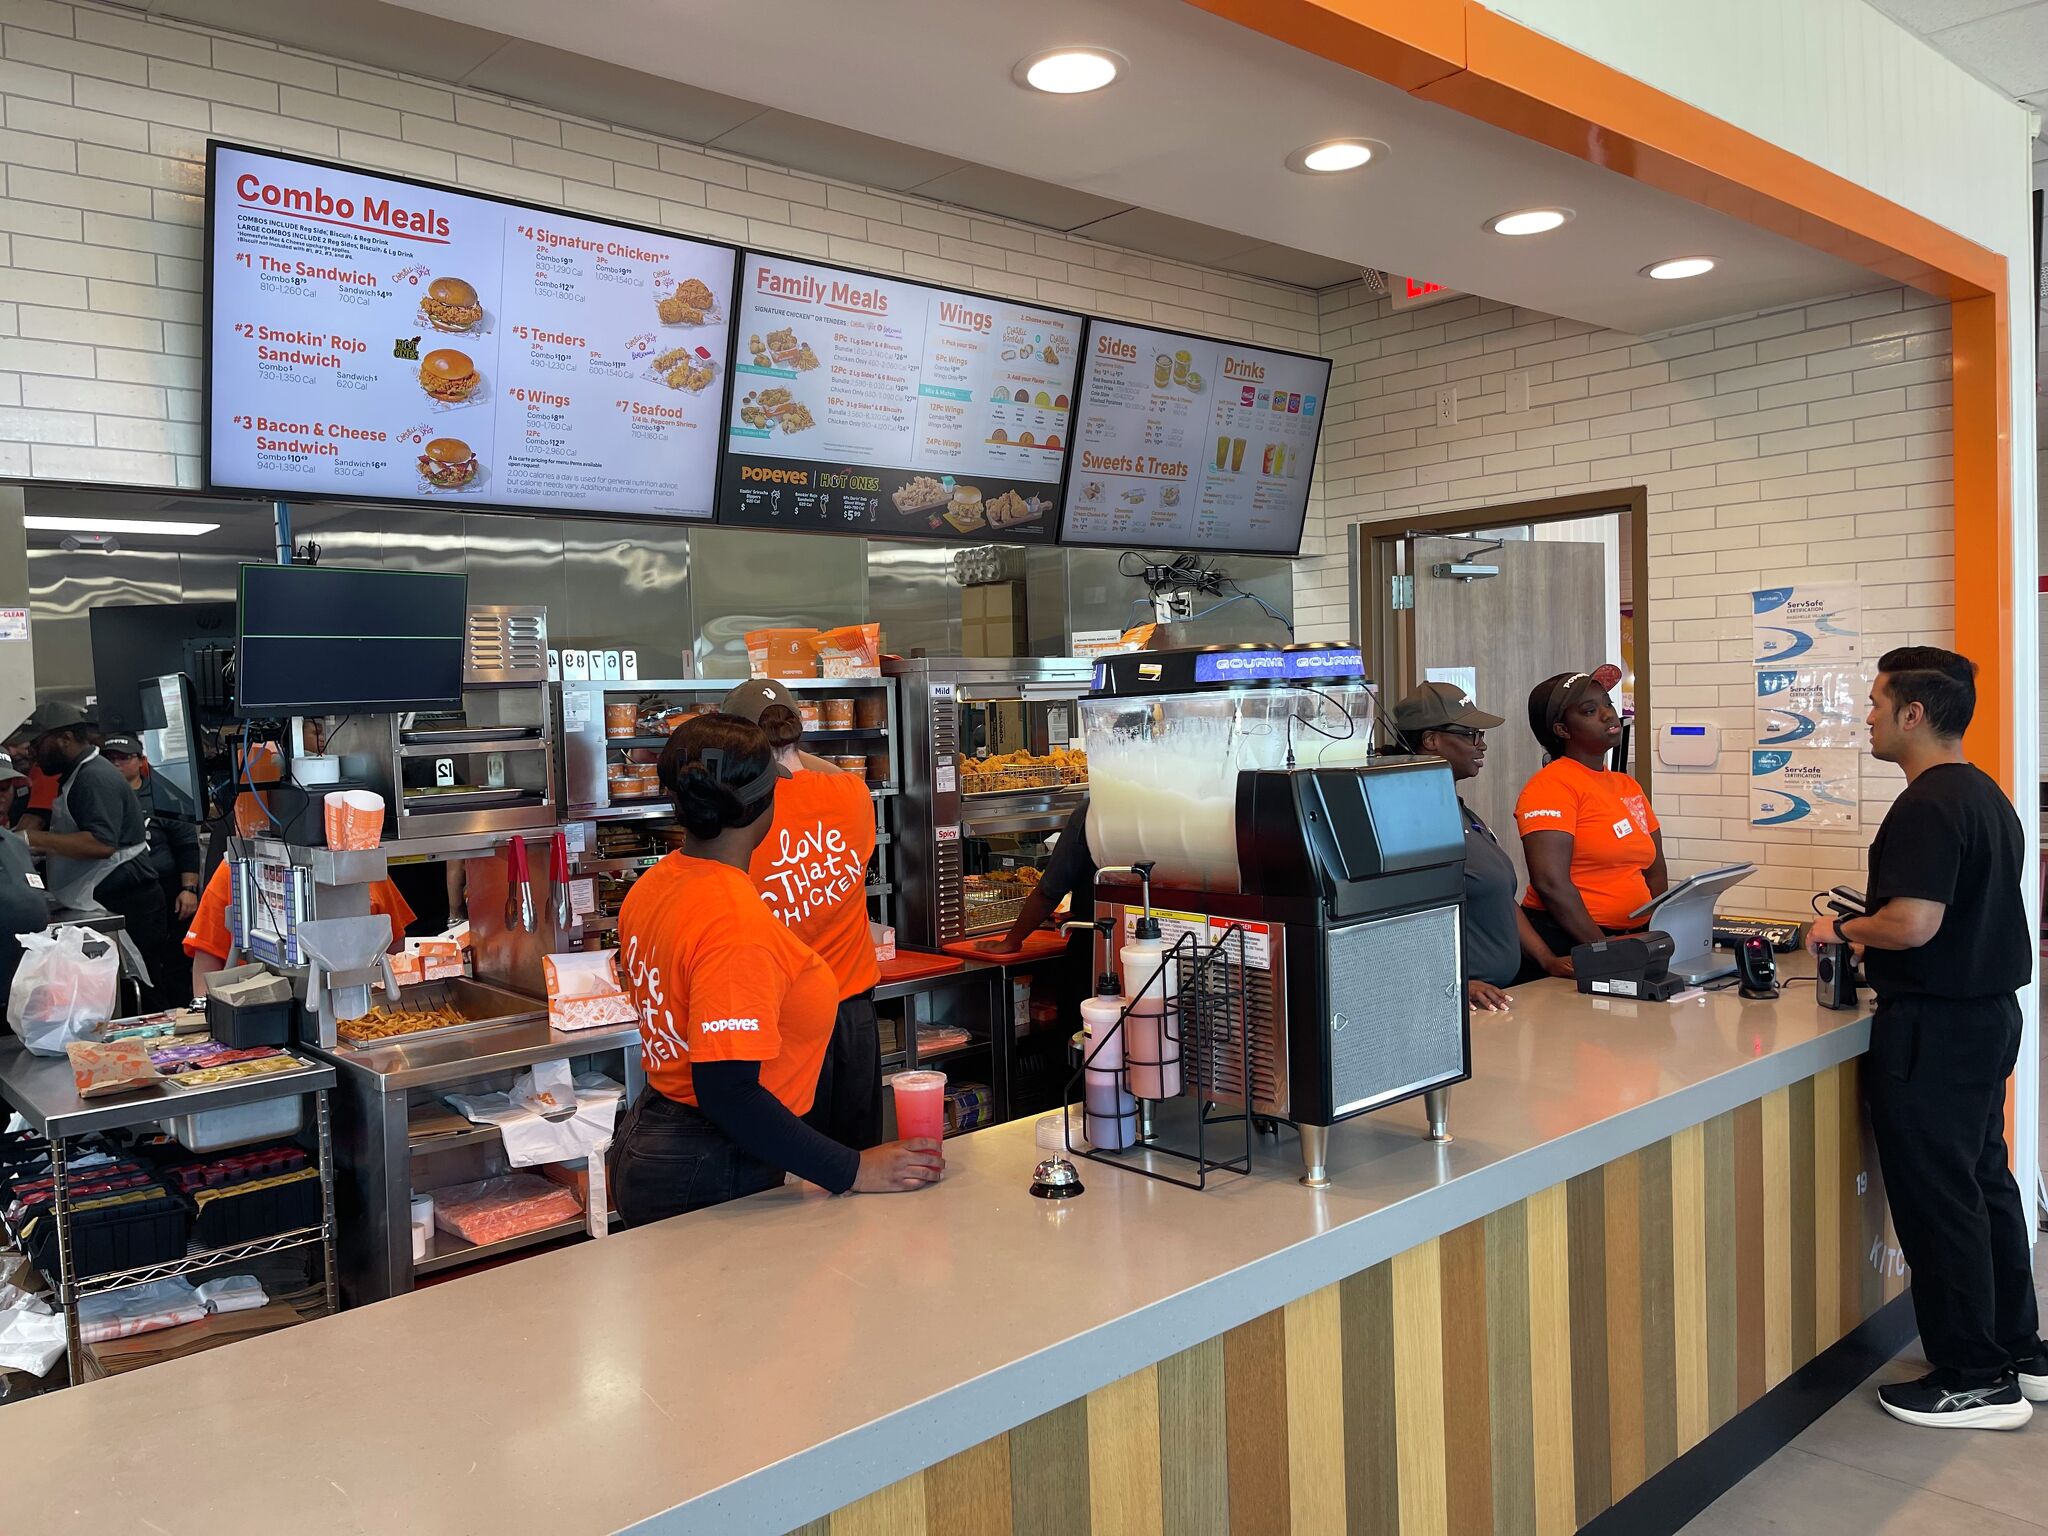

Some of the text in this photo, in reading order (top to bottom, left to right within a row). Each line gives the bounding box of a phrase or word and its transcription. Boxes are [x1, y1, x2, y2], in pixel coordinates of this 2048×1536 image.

[236, 173, 451, 237] Combo Meals
[237, 214, 389, 246] COMBOS INCLUDE Reg Reg Drink
[237, 222, 414, 259] LARGE COMBOS INCLUDE Reg Drink
[517, 225, 604, 253] #4 Signature
[536, 245, 549, 254] 2Pc
[535, 253, 560, 264] Combo
[596, 256, 609, 264] 3Pc
[235, 253, 377, 287] #1 The Sandwich
[571, 267, 584, 277] Cal
[595, 264, 619, 274] Combo
[260, 272, 290, 284] Combo
[534, 279, 559, 289] Combo
[756, 267, 888, 311] Family Meals
[302, 288, 317, 298] Cal
[338, 284, 376, 297] Sandwich
[339, 293, 370, 306] 700 Cal
[754, 305, 786, 317] SIGNATURE
[940, 301, 993, 332] Wings
[234, 323, 367, 354] #2 Smokin' Rojo
[512, 325, 586, 348] #5 Tenders
[833, 332, 848, 343] 8Pc
[531, 343, 544, 351] 3Pc
[1097, 335, 1137, 359] Sides
[258, 345, 341, 369] Sandwich
[530, 351, 555, 360] Combo
[833, 354, 855, 363] Chicken
[935, 354, 968, 367] 6Pc Wings
[258, 362, 289, 372] Combo
[565, 363, 577, 372] Cal
[589, 358, 612, 368] Combo
[1224, 357, 1265, 380] Drinks
[831, 365, 847, 375] 12Pc
[302, 375, 316, 385] Cal
[336, 371, 374, 382] Sandwich
[336, 380, 368, 391] 620 Cal
[509, 388, 571, 408] #6 Wings
[827, 396, 844, 406] 16Pc
[527, 404, 540, 412] 6Pc
[615, 400, 683, 419] #7 Seafood
[930, 403, 964, 415] 12Pc Wings
[527, 411, 551, 421] Combo
[233, 415, 387, 442] #3 Bacon & Cheese
[561, 423, 573, 431] Cal
[631, 423, 653, 431] Combo
[650, 417, 697, 429] Popcorn Shrimp
[526, 429, 541, 437] 12Pc
[256, 436, 339, 456] Sandwich
[525, 437, 549, 446] Combo
[926, 437, 961, 449] 24Pc Wings
[257, 452, 287, 461] Combo
[565, 448, 577, 457] Cal
[334, 458, 371, 468] Sandwich
[1082, 450, 1133, 472] Sweets
[1135, 455, 1145, 473] &
[1147, 456, 1188, 477] Treats
[302, 465, 316, 473] Cal
[334, 467, 365, 477] 830 Cal
[529, 471, 658, 488] calories used general nutrition
[819, 473, 848, 488] HOT
[849, 475, 880, 491] ONES
[512, 487, 561, 498] available upon
[519, 478, 675, 497] calorie needs Additional nutrition information
[1787, 599, 1824, 609] ServSafe
[935, 686, 950, 695] Mild
[938, 830, 957, 839] Spicy
[1856, 1171, 1868, 1196] 19
[1869, 1234, 1906, 1278] KITC
